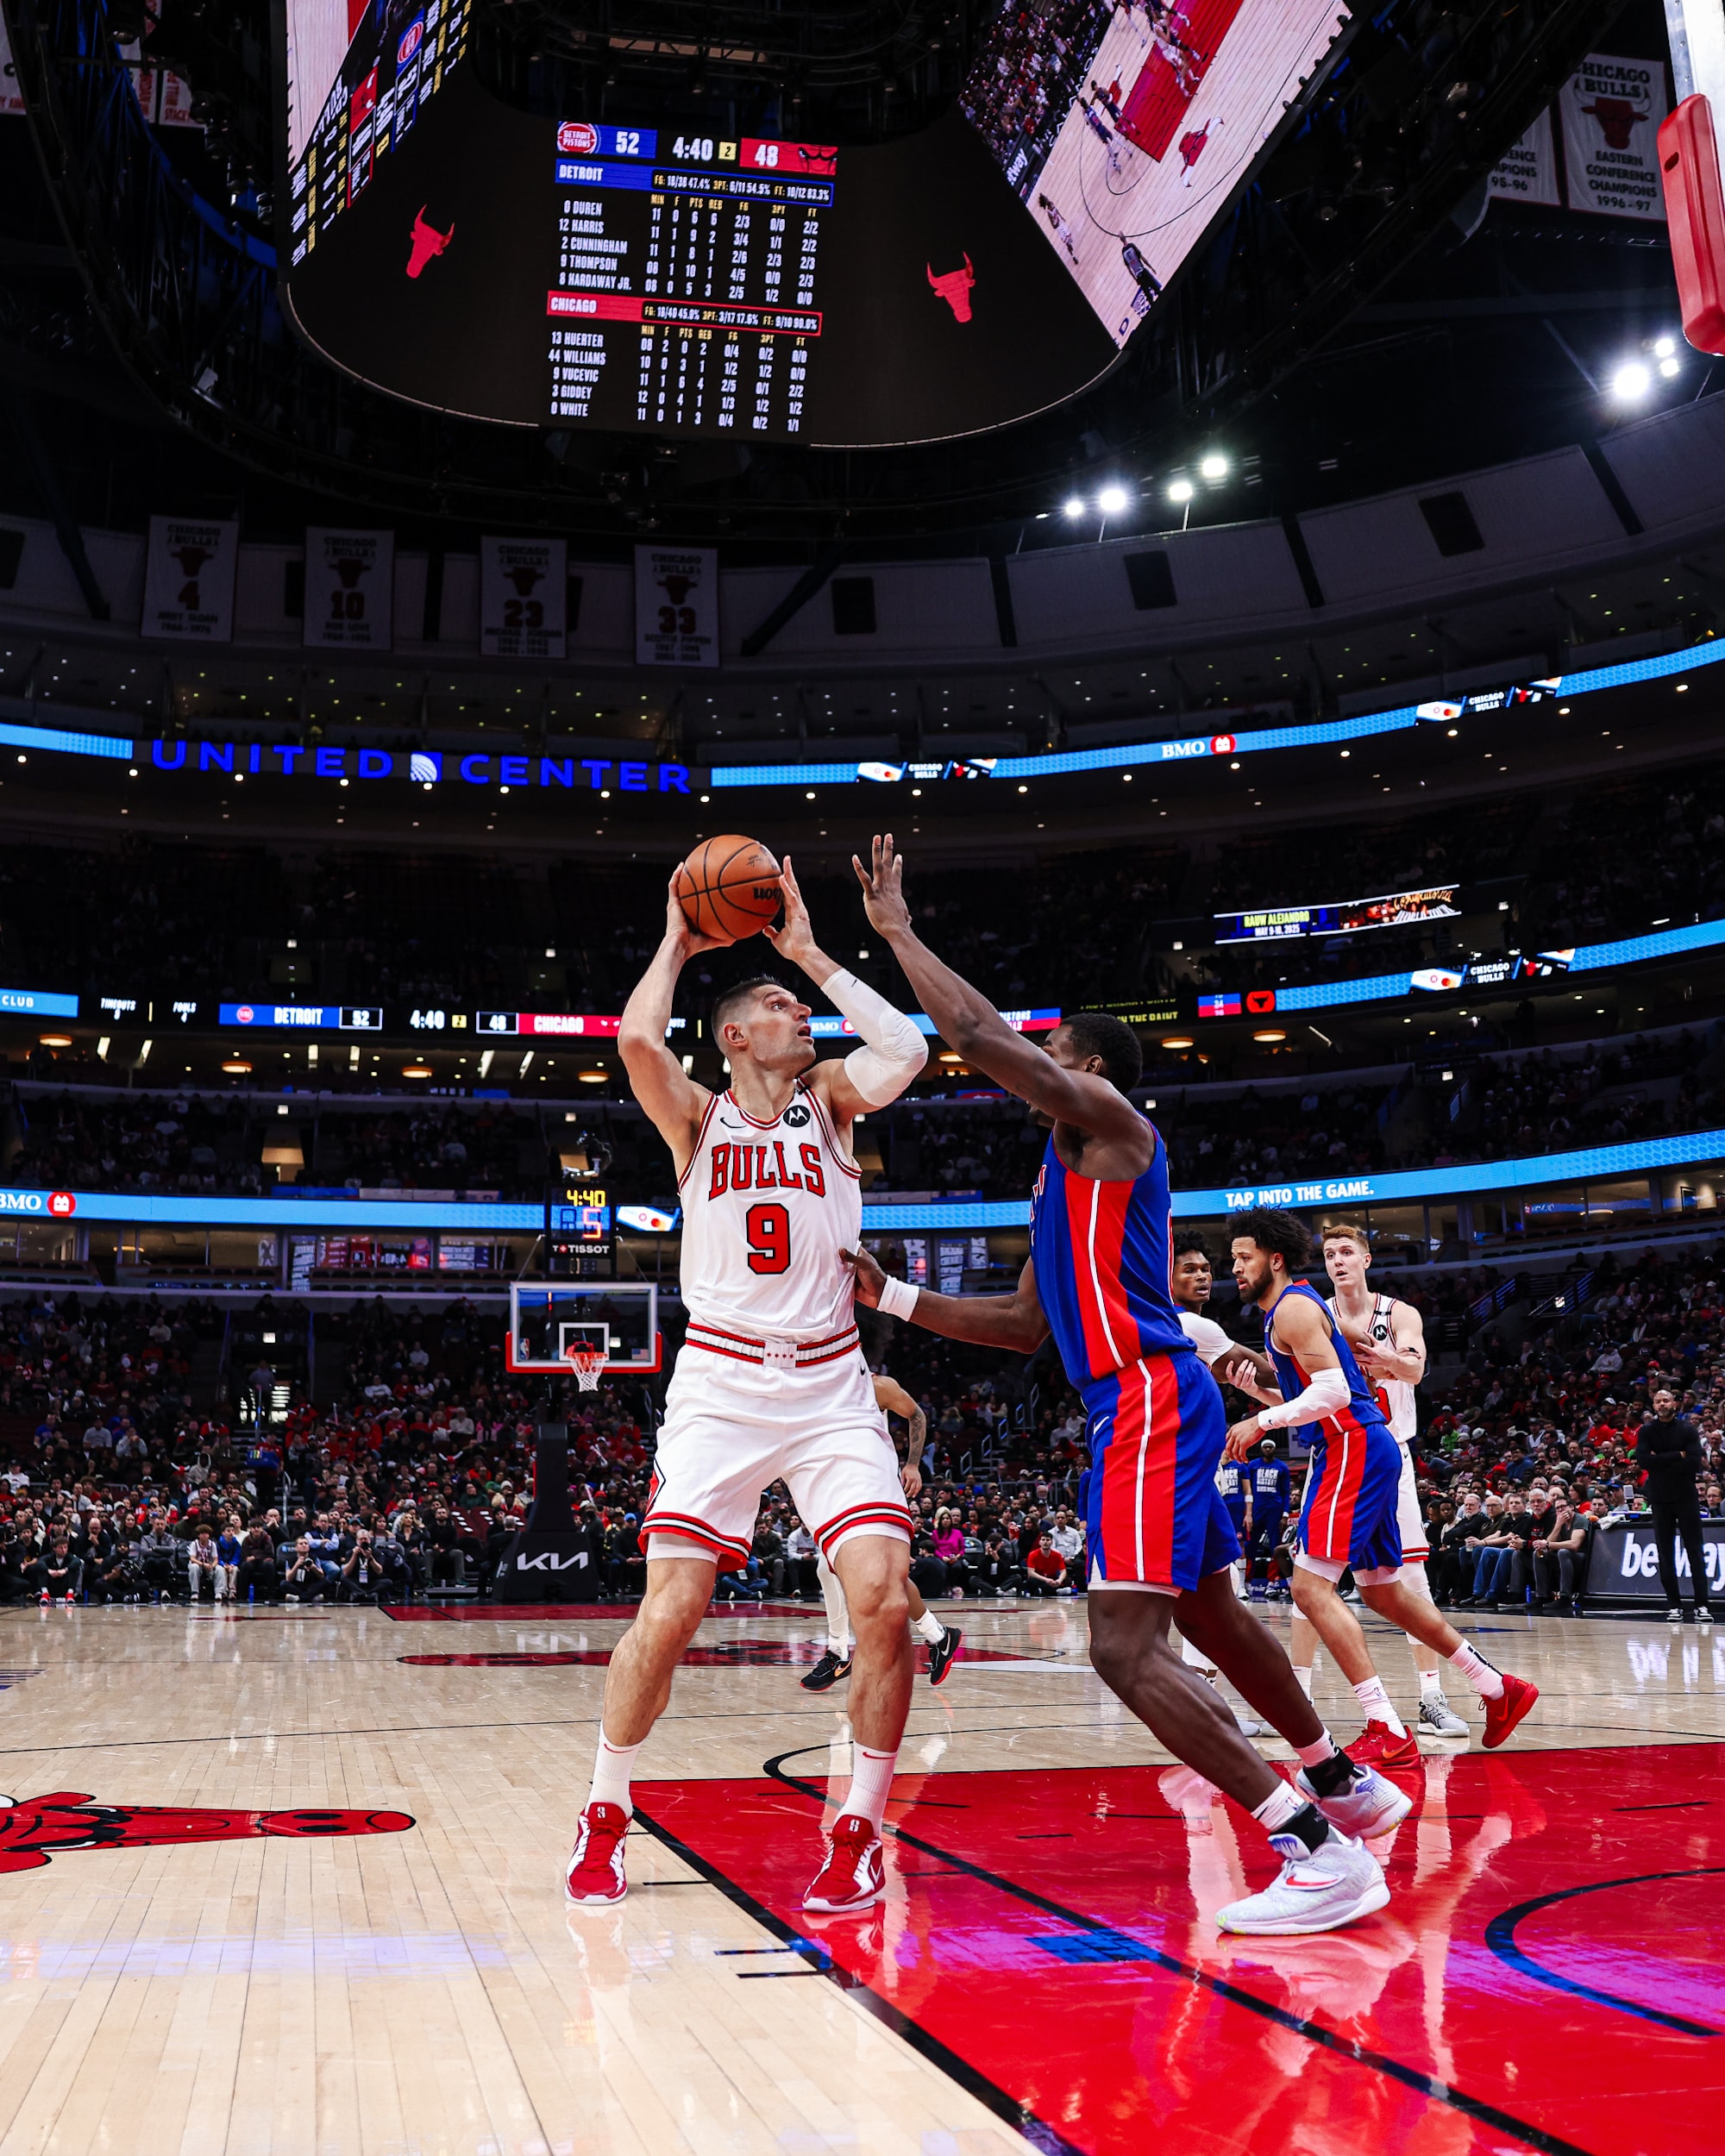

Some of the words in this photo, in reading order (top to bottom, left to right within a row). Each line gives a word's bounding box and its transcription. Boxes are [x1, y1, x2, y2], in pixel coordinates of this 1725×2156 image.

[1584, 78, 1641, 98] BULLS
[616, 131, 640, 154] 52
[673, 136, 714, 161] 4:40
[724, 146, 732, 158] 2
[755, 144, 779, 167] 48
[1596, 151, 1643, 166] EASTERN
[559, 165, 604, 181] DETROIT
[1494, 164, 1537, 178] PIONS
[1586, 164, 1657, 183] CONFERENCE
[1491, 176, 1527, 191] 95-96
[1588, 179, 1657, 197] CHAMPIONS
[689, 197, 704, 209] PTS
[807, 208, 818, 217] FT
[563, 200, 571, 214] 0
[573, 201, 603, 216] DUREN
[734, 215, 750, 229] 2/3
[803, 221, 819, 235] 2/2
[559, 218, 569, 231] 12
[571, 219, 604, 234] HARRIS
[733, 233, 749, 247] 3/4
[801, 239, 817, 253] 2/2
[561, 236, 568, 249] 2
[570, 236, 628, 254] CUNNINGHAM
[731, 250, 748, 264] 2/6
[800, 256, 815, 270] 2/3
[561, 254, 568, 267] 9
[569, 254, 618, 272] THOMPSON
[685, 264, 696, 278] 10
[730, 268, 746, 282] 4/5
[798, 274, 814, 287] 2/3
[559, 272, 566, 285] 8
[568, 273, 617, 290] HARDAWAY
[618, 277, 632, 291] JR.
[729, 285, 744, 300] 2/5
[797, 291, 812, 305] 0/0
[550, 297, 597, 313] CHICAGO
[718, 311, 736, 323] 3/17
[551, 331, 561, 345] 13
[564, 332, 604, 348] HUERTER
[724, 344, 739, 358] 0/4
[792, 350, 807, 364] 0/0
[549, 348, 561, 362] 44
[563, 349, 606, 366] WILLIAMS
[724, 362, 738, 375] 1/2
[790, 367, 806, 380] 0/0
[553, 367, 560, 379] 9
[562, 367, 599, 382] VUCEVIC
[721, 379, 737, 392] 2/5
[788, 385, 804, 398] 2/2
[552, 384, 559, 398] 3
[561, 385, 593, 399] GIDDEY
[721, 396, 735, 410] 1/3
[789, 402, 803, 415] 1/2
[550, 401, 557, 415] 0
[560, 402, 588, 417] WHITE
[718, 413, 733, 427] 0/4
[787, 418, 800, 432] 1/1
[167, 524, 221, 537] CHICAGO
[324, 536, 377, 548] CHICAGO
[498, 545, 549, 555] CHICAGO
[651, 554, 702, 565] CHICAGO
[179, 581, 200, 611] 4
[331, 591, 365, 620] 10
[505, 600, 544, 628] 23
[658, 606, 697, 635] 33
[1469, 692, 1504, 705] CHICAGO
[1475, 701, 1500, 712] BULLS
[1162, 742, 1206, 759] BMO
[152, 739, 393, 780] UNITED
[460, 754, 691, 793] CENTER
[908, 763, 943, 772] CHICAGO
[1244, 914, 1267, 928] RAUW
[1268, 911, 1310, 925] ALEJANDRO
[1470, 962, 1509, 976] CHICAGO
[1477, 972, 1504, 984] BULLS
[1, 994, 35, 1009] CLUB
[101, 998, 136, 1012] TIMEOUTS
[172, 1001, 198, 1013] FOULS
[273, 1007, 323, 1025] DETROIT
[352, 1010, 369, 1027] 52
[410, 1009, 445, 1030] 4:40
[489, 1013, 507, 1032] 48
[533, 1015, 585, 1035] CHICAGO
[811, 1021, 839, 1033] BMO
[708, 1141, 826, 1201] BULLS
[567, 1189, 605, 1207] 4:40
[1226, 1191, 1255, 1207] TAP
[1258, 1188, 1293, 1206] INTO
[1295, 1184, 1323, 1201] THE
[1325, 1181, 1375, 1199] GAME.
[582, 1207, 602, 1239] 5
[746, 1203, 791, 1275] 9
[567, 1244, 610, 1254] TISSOT
[1224, 1469, 1239, 1480] ACK
[518, 1551, 588, 1570] KIA
[1621, 1532, 1725, 1592] beway
